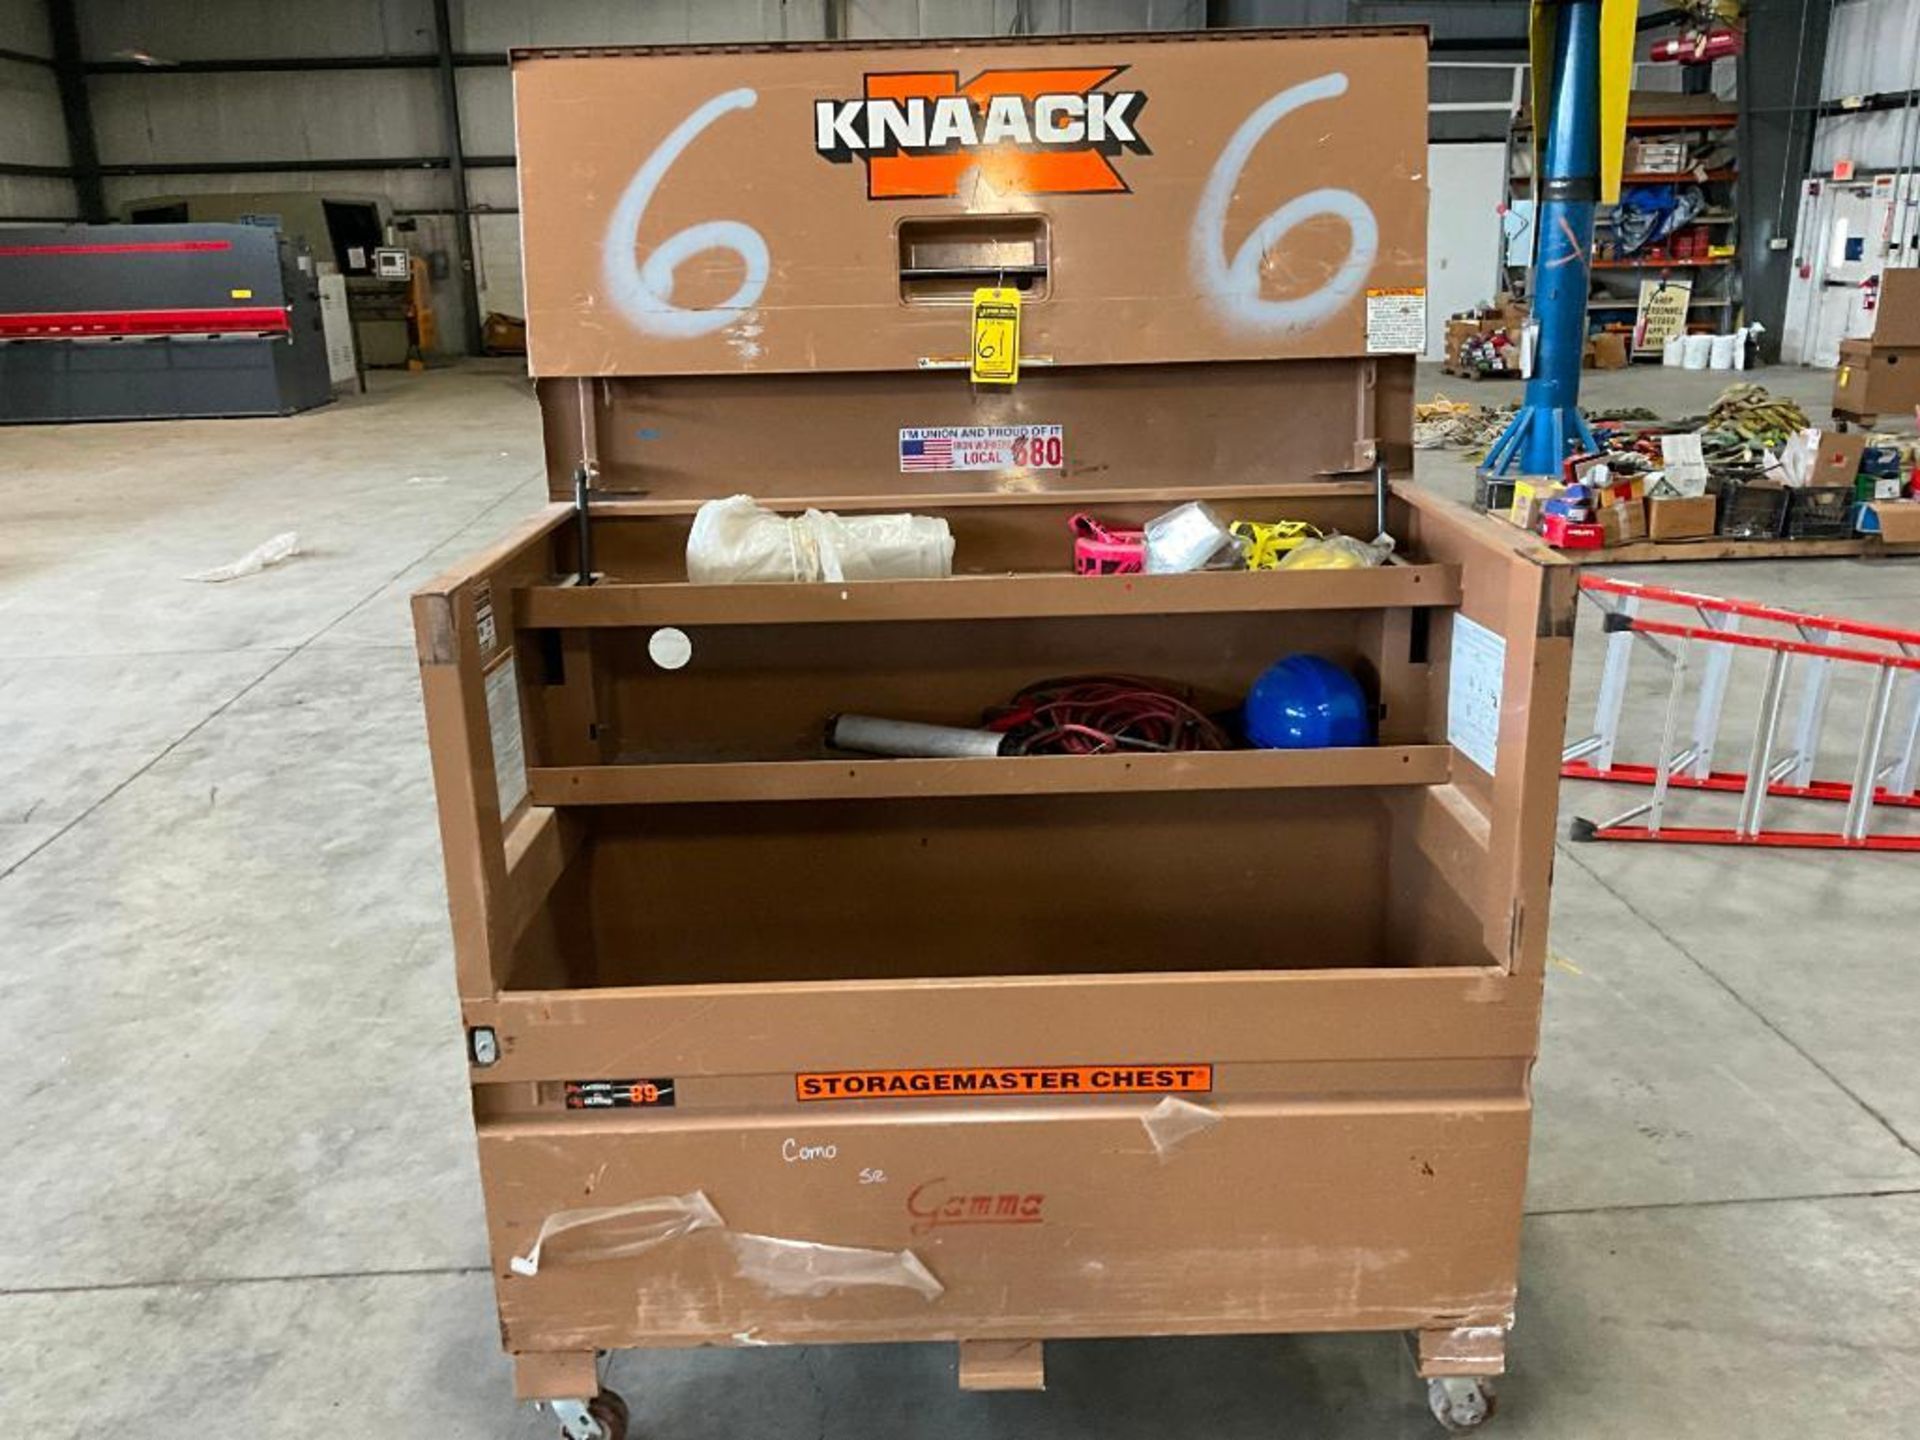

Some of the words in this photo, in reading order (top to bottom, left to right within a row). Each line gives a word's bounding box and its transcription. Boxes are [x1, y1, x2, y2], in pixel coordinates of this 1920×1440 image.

[815, 92, 1140, 152] KNAACK
[604, 87, 770, 338] 6
[1192, 72, 1379, 332] 6
[977, 329, 1005, 358] 61
[902, 430, 918, 439] I'M
[921, 429, 958, 438] UNION
[961, 428, 985, 438] AND
[988, 427, 1029, 437] PROUD
[1032, 427, 1046, 436] OF
[1050, 426, 1060, 435] IT
[964, 452, 1003, 464] LOCAL
[803, 1071, 1080, 1095] STORAGEMASTER
[1090, 1070, 1195, 1088] CHEST
[782, 1138, 837, 1162] Como
[907, 1177, 1047, 1237] Gamma
